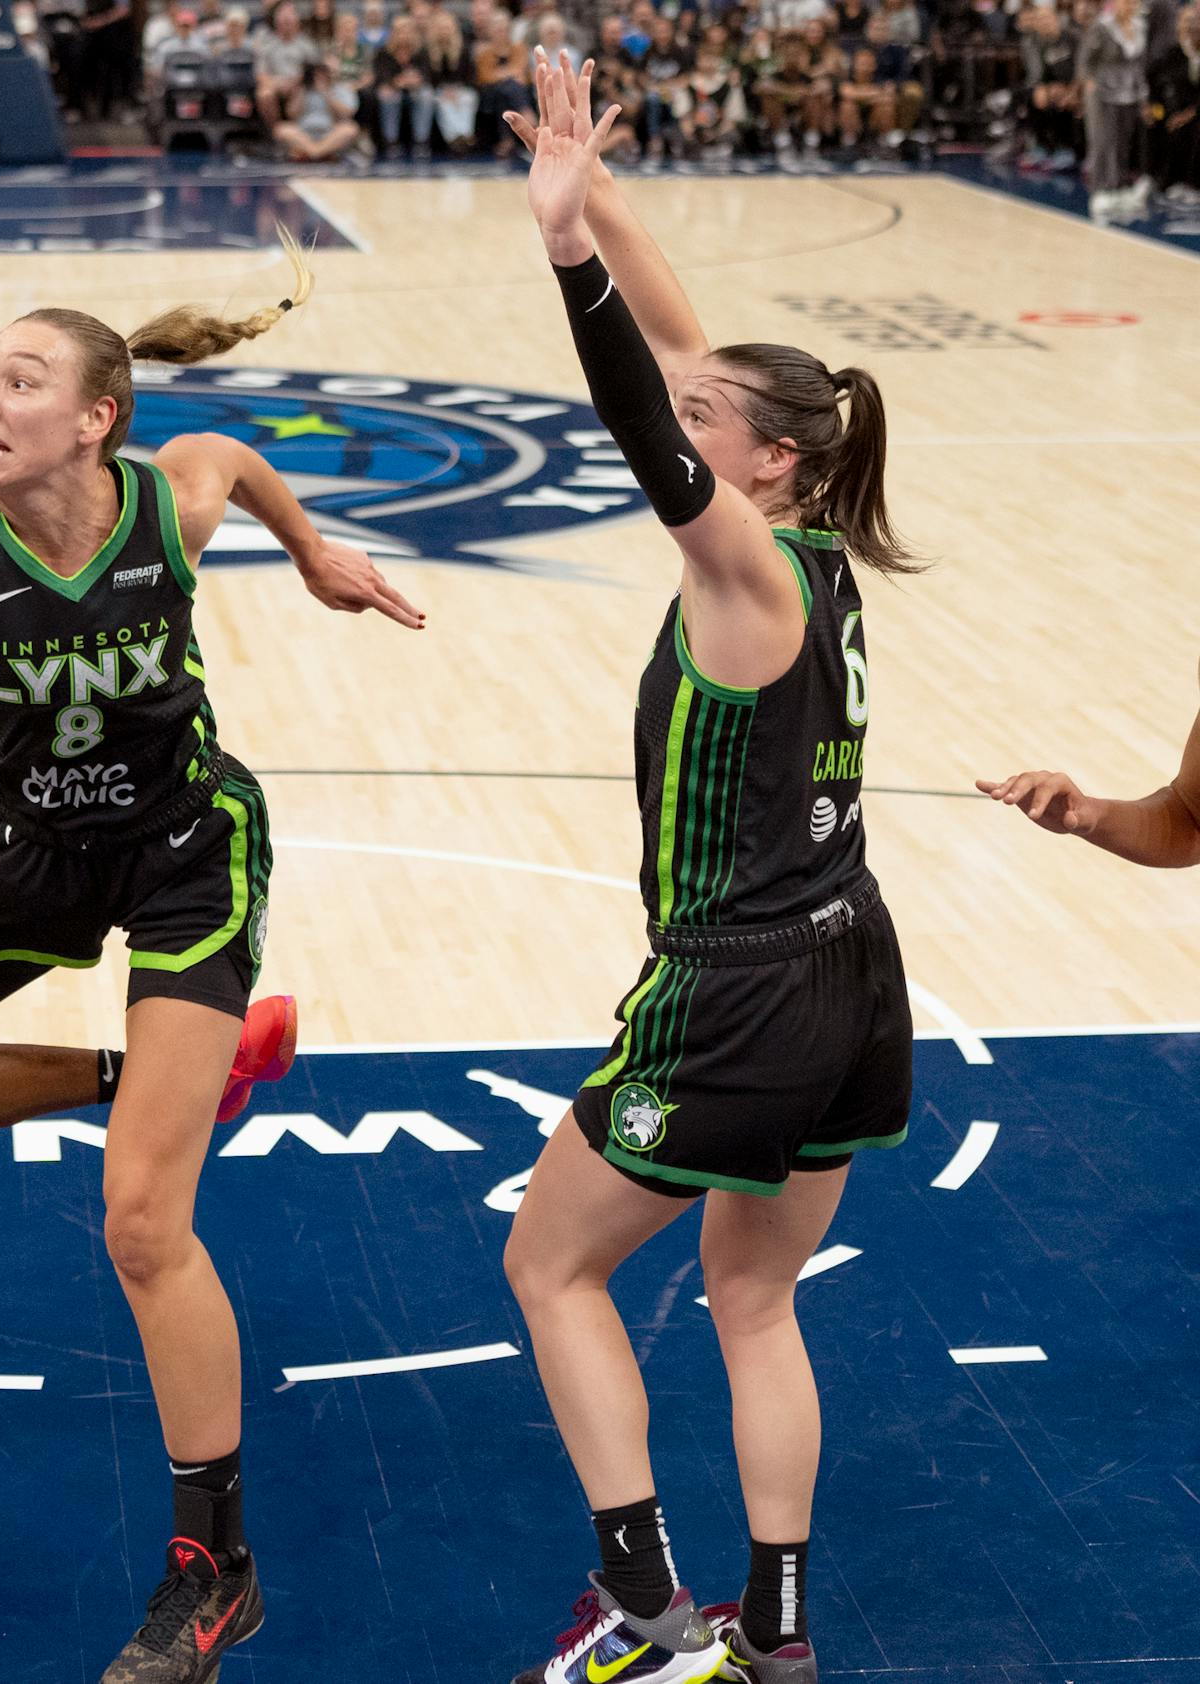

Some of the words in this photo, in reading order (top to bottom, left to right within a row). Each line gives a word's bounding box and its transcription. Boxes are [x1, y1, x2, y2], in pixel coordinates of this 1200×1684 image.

[113, 563, 163, 582] FEDERATED
[841, 611, 869, 726] 6
[51, 704, 104, 758] 8
[30, 763, 129, 789] MAYO
[21, 778, 136, 808] CLINIC
